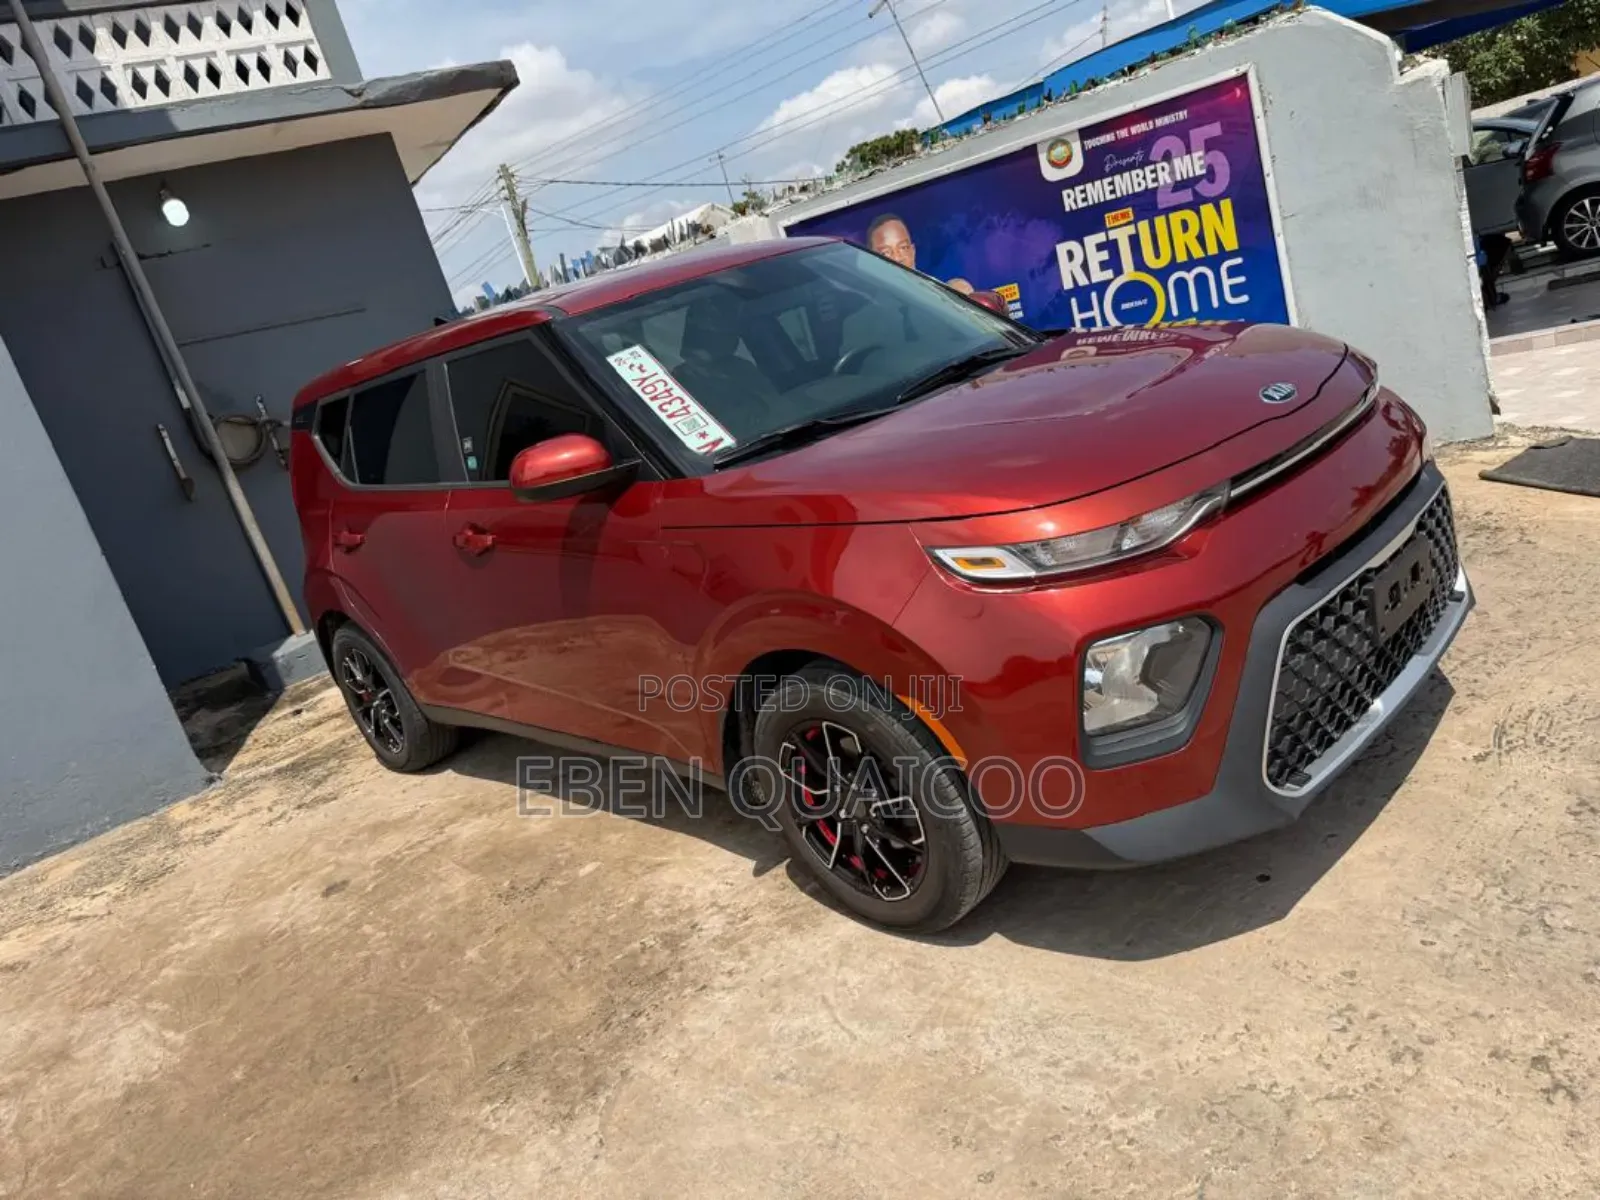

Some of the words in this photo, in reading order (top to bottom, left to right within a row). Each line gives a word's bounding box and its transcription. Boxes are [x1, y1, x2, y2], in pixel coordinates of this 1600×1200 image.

[1084, 132, 1116, 151] TOUCHING
[1116, 127, 1129, 140] THE
[1130, 120, 1154, 136] WORLD
[1155, 109, 1188, 129] MINISTRY
[1062, 161, 1171, 212] REMEMBER
[1174, 151, 1207, 182] ME
[1149, 122, 1231, 210] 25
[1055, 198, 1239, 290] RETURN
[1107, 209, 1132, 226] THEME
[1070, 257, 1250, 332] HOME
[1262, 382, 1295, 402] KIA
